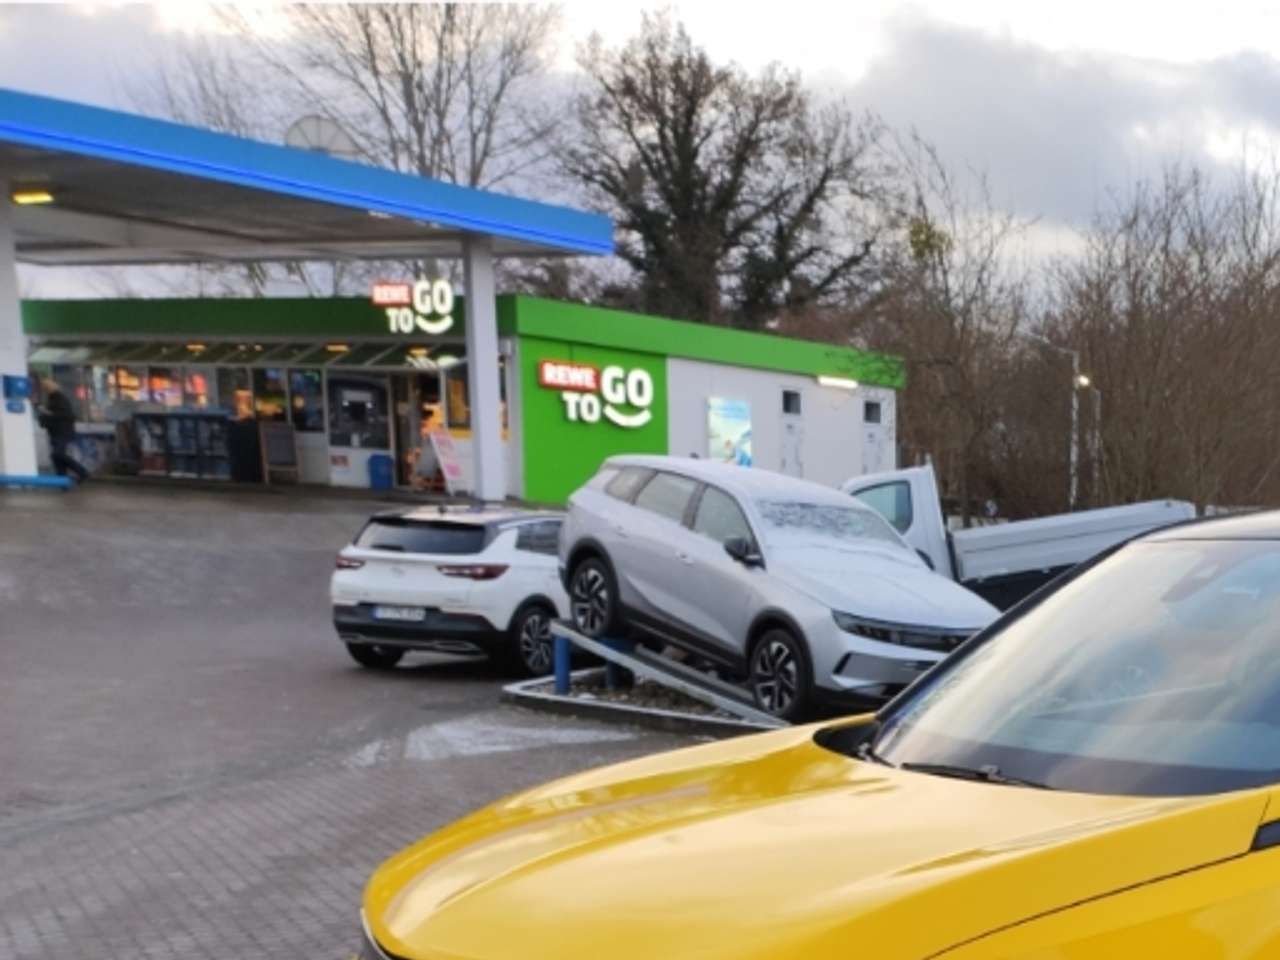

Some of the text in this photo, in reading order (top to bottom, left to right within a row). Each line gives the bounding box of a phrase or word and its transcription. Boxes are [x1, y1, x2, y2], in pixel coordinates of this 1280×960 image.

[372, 284, 410, 305] REWE
[385, 279, 454, 333] TO GO
[543, 362, 597, 389] REWE
[562, 365, 654, 422] TO GO
